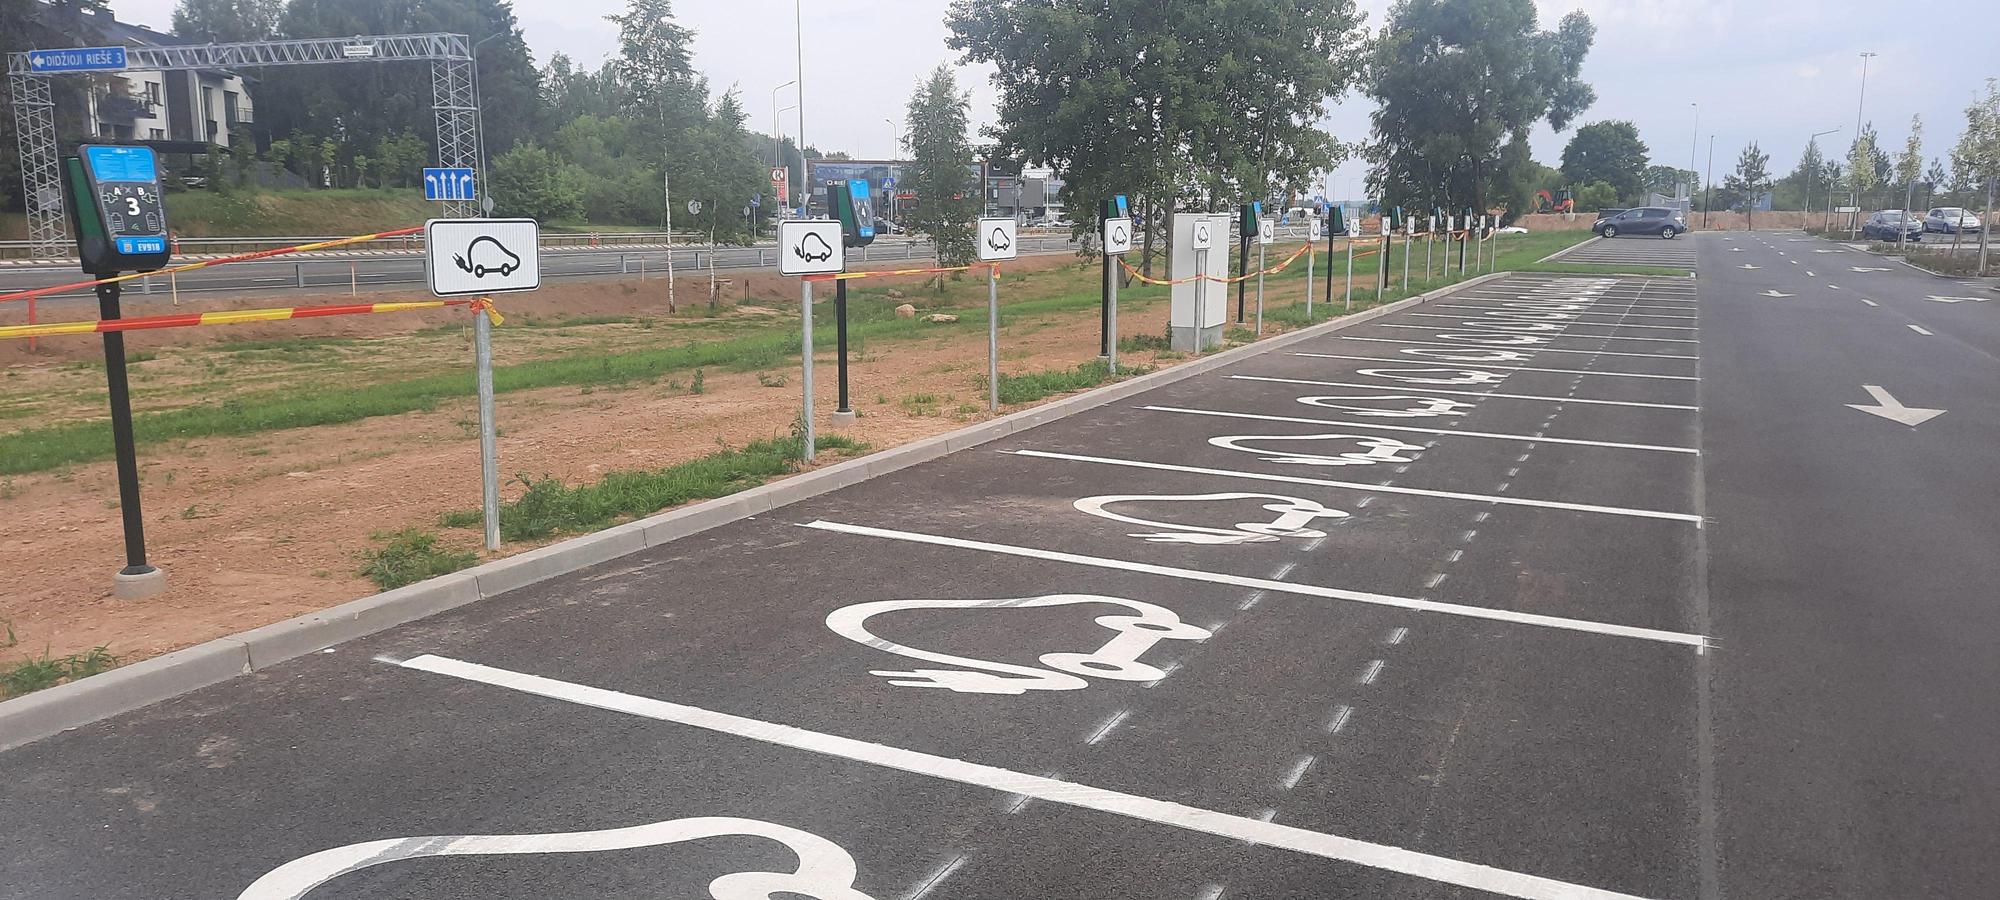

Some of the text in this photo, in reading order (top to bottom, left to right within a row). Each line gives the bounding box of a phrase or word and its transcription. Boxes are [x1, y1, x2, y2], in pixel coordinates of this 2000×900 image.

[46, 52, 83, 67] DIDŽIOJI
[116, 52, 123, 64] 3
[114, 187, 145, 196] A B
[126, 197, 141, 216] 3
